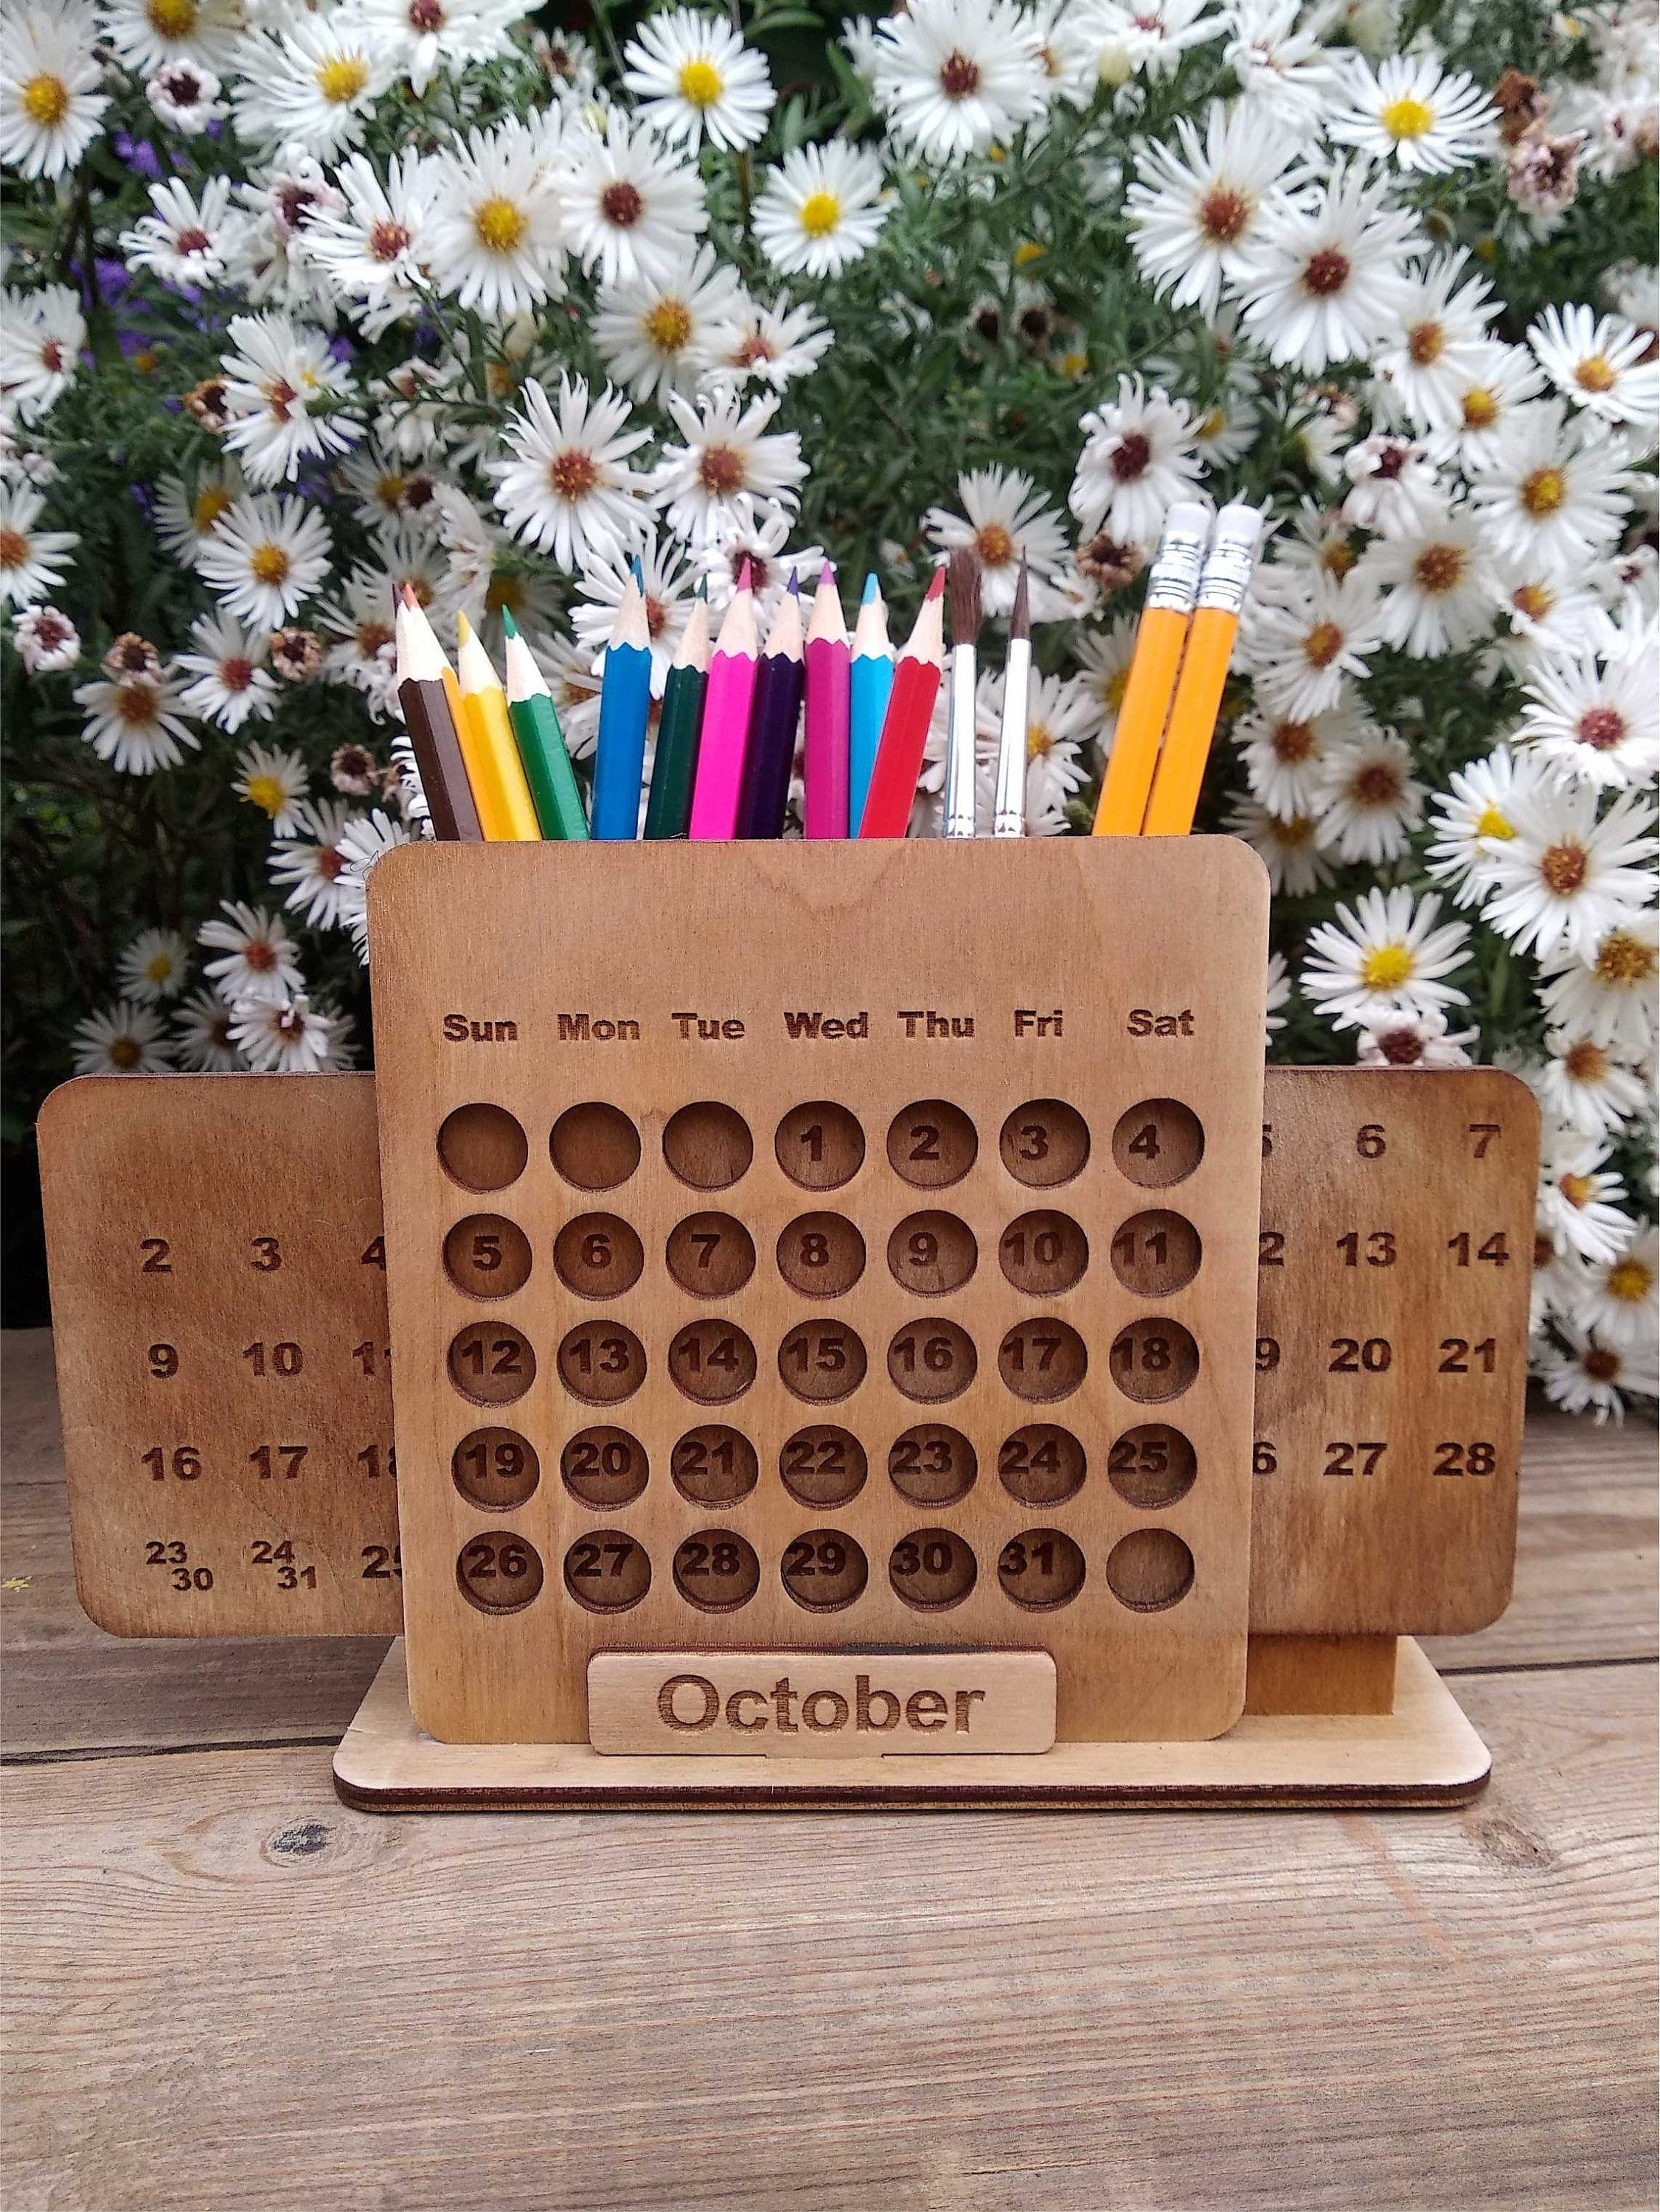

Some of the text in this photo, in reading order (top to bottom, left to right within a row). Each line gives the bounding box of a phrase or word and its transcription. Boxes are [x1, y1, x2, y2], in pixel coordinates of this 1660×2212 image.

[443, 1009, 1195, 1042] Sun Mon Tue Wed Thu Fri Sat
[801, 1124, 1160, 1162] 1 2 3 4
[1356, 1124, 1501, 1158] 6 7
[140, 1236, 386, 1273] 2 3 4
[472, 1231, 1167, 1271] 5 6 7 8 9 10 11
[1258, 1232, 1509, 1267] 2 13 14
[148, 1341, 392, 1379] 9 10 1
[461, 1337, 1172, 1375] 12 13 14 15 16 17 18
[1255, 1338, 1496, 1374] 9 20 21
[142, 1445, 397, 1481] 16 17 1
[465, 1441, 1168, 1478] 19 20 21 22 23 24 25
[1252, 1441, 1496, 1475] 6 27 28
[146, 1540, 187, 1565] 23
[251, 1540, 295, 1564] 24
[468, 1542, 1055, 1579] 26 27 28 29 30 31
[173, 1566, 316, 1591] 30 31
[657, 1674, 986, 1734] October
